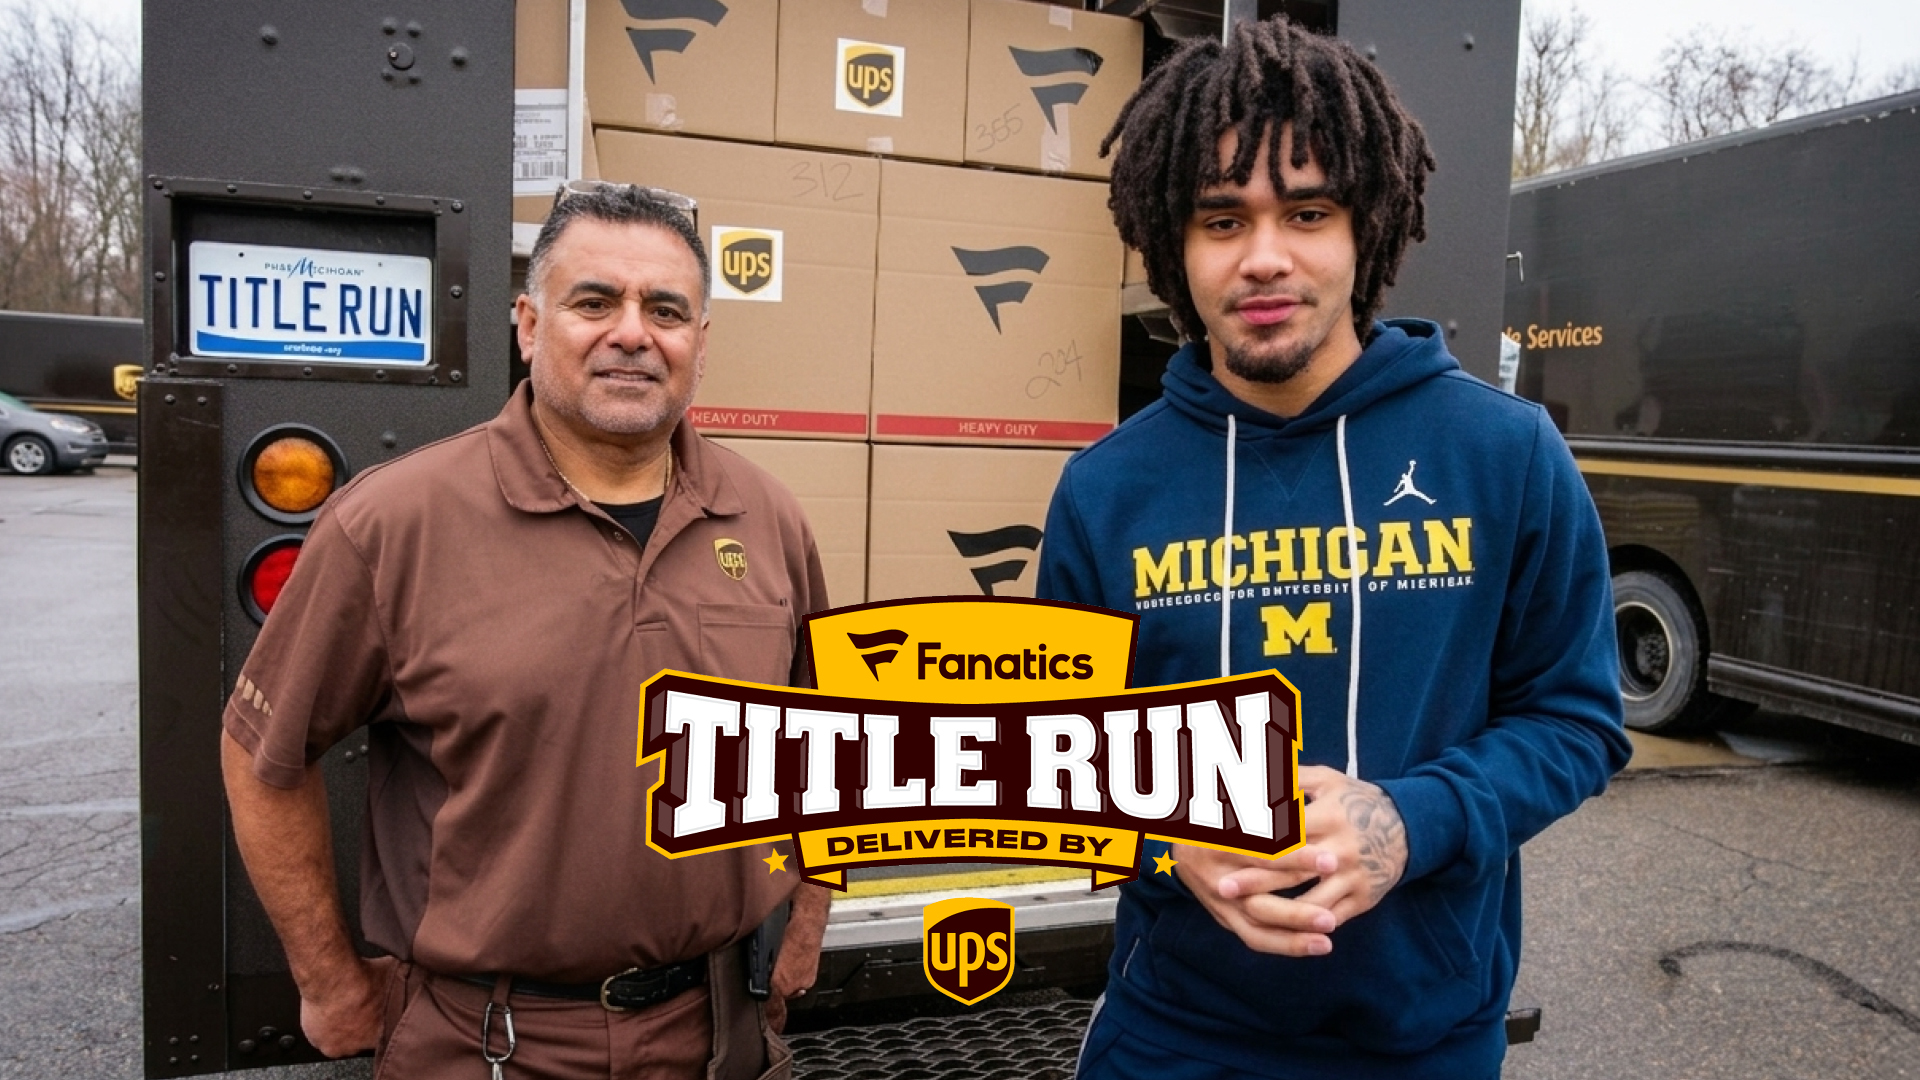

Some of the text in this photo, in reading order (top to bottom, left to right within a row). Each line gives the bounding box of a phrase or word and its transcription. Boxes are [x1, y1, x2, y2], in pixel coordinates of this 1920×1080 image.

[848, 63, 892, 99] ups
[786, 160, 865, 202] 312
[723, 249, 771, 286] ups
[198, 274, 422, 339] TITLE RUN
[1526, 321, 1603, 350] Services
[691, 410, 779, 427] HEAVY DUTY
[1132, 517, 1475, 598] MICHIGAN
[1367, 579, 1389, 593] OF
[1259, 601, 1335, 657] M
